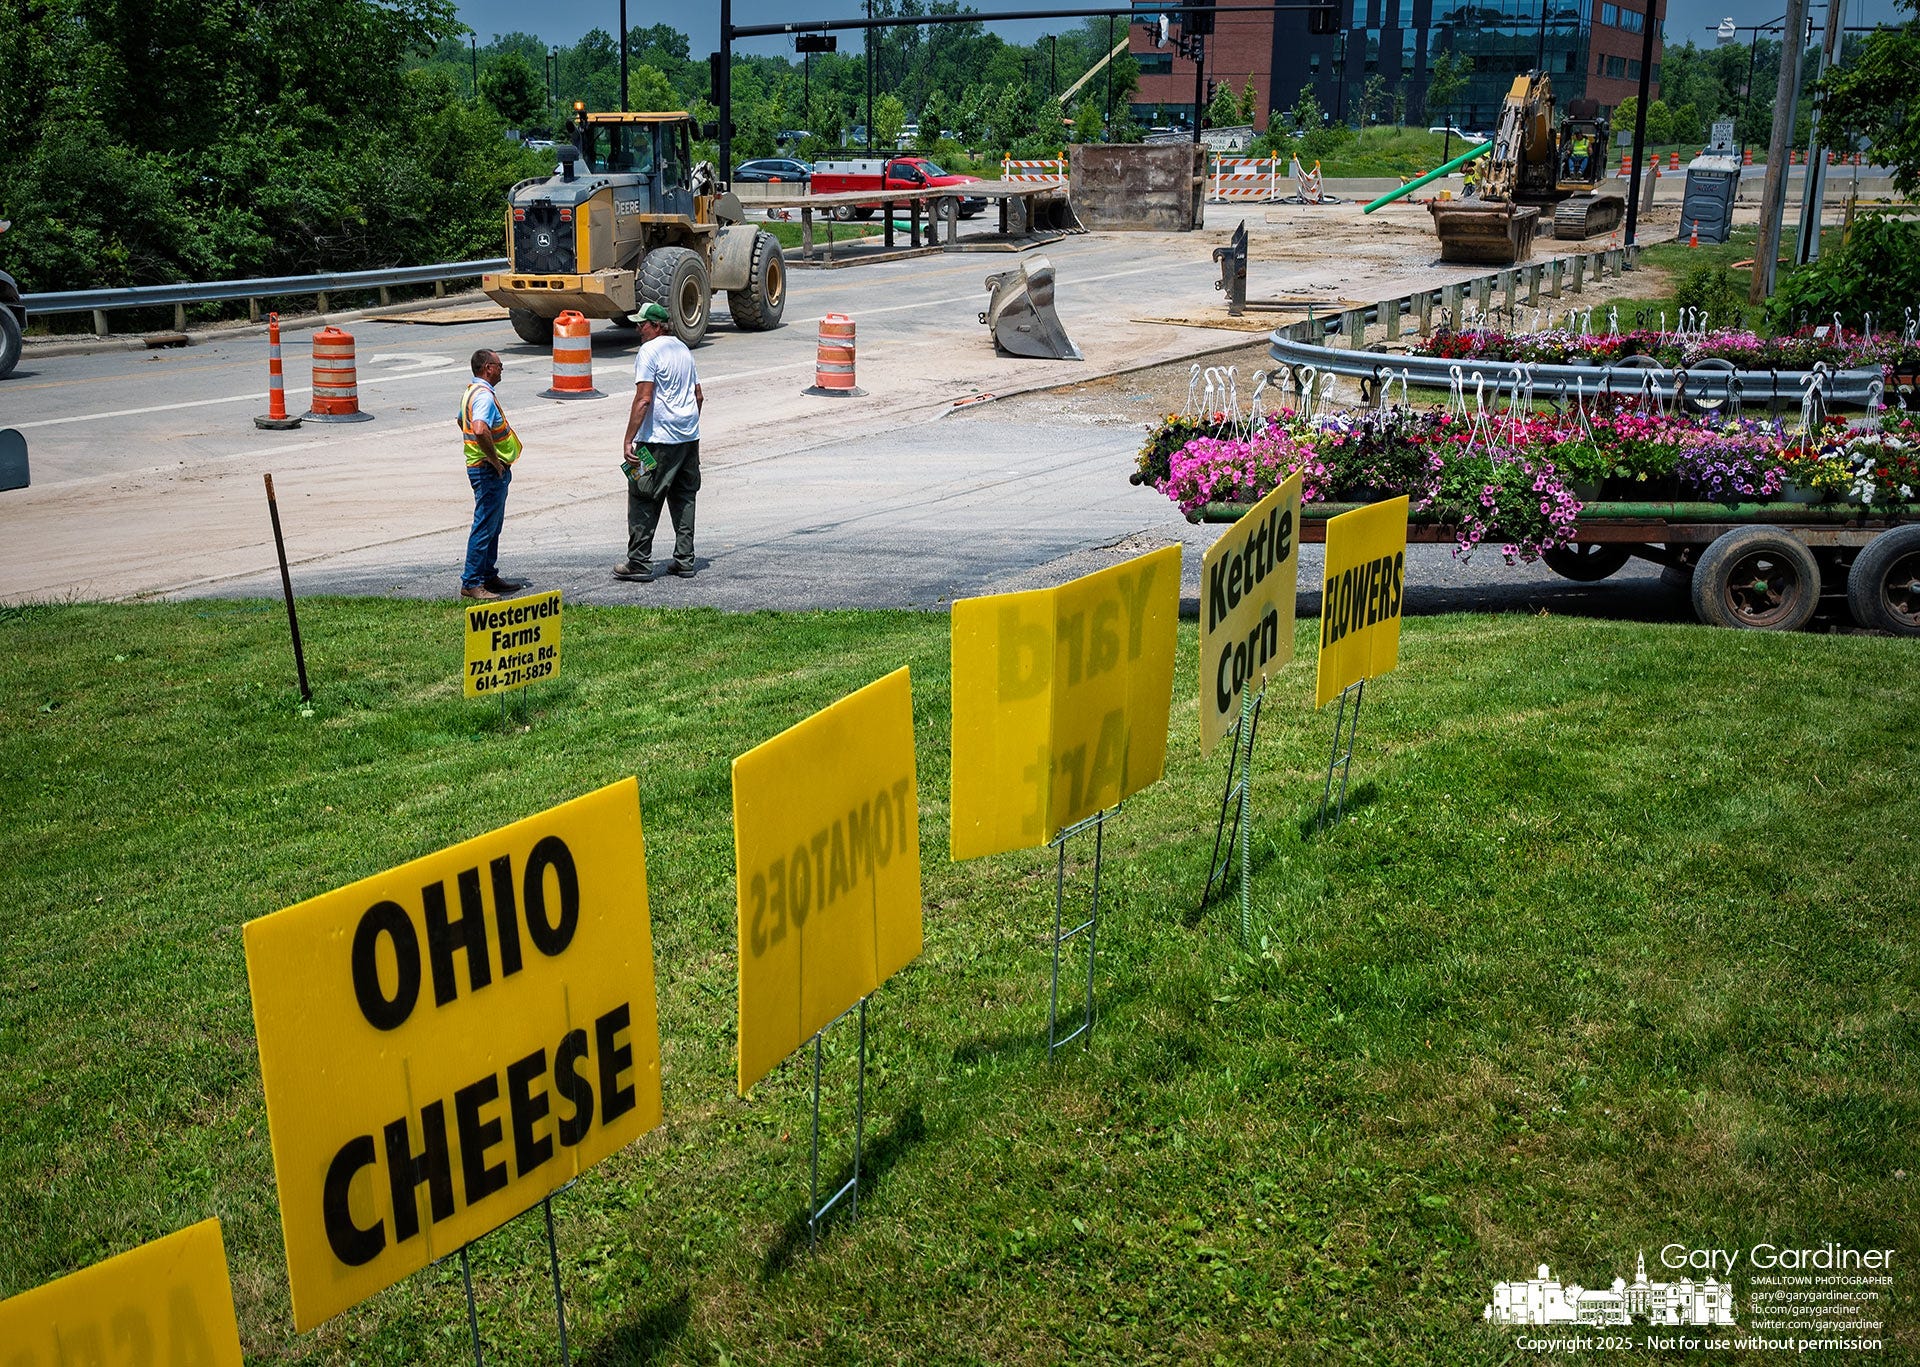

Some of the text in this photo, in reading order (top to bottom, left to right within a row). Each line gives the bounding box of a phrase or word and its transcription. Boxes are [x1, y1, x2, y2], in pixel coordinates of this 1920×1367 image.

[614, 200, 640, 215] DEERE
[1208, 506, 1293, 635] Kettle
[1321, 550, 1404, 650] FLOWERS
[469, 596, 560, 632] Westervelt
[491, 626, 541, 651] Farms
[470, 645, 558, 675] 724 Africa Rd.
[476, 661, 552, 691] 614-271-5829
[1216, 608, 1278, 714] Corn
[351, 835, 580, 1032] OHIO
[322, 1001, 637, 1267] CHEESE
